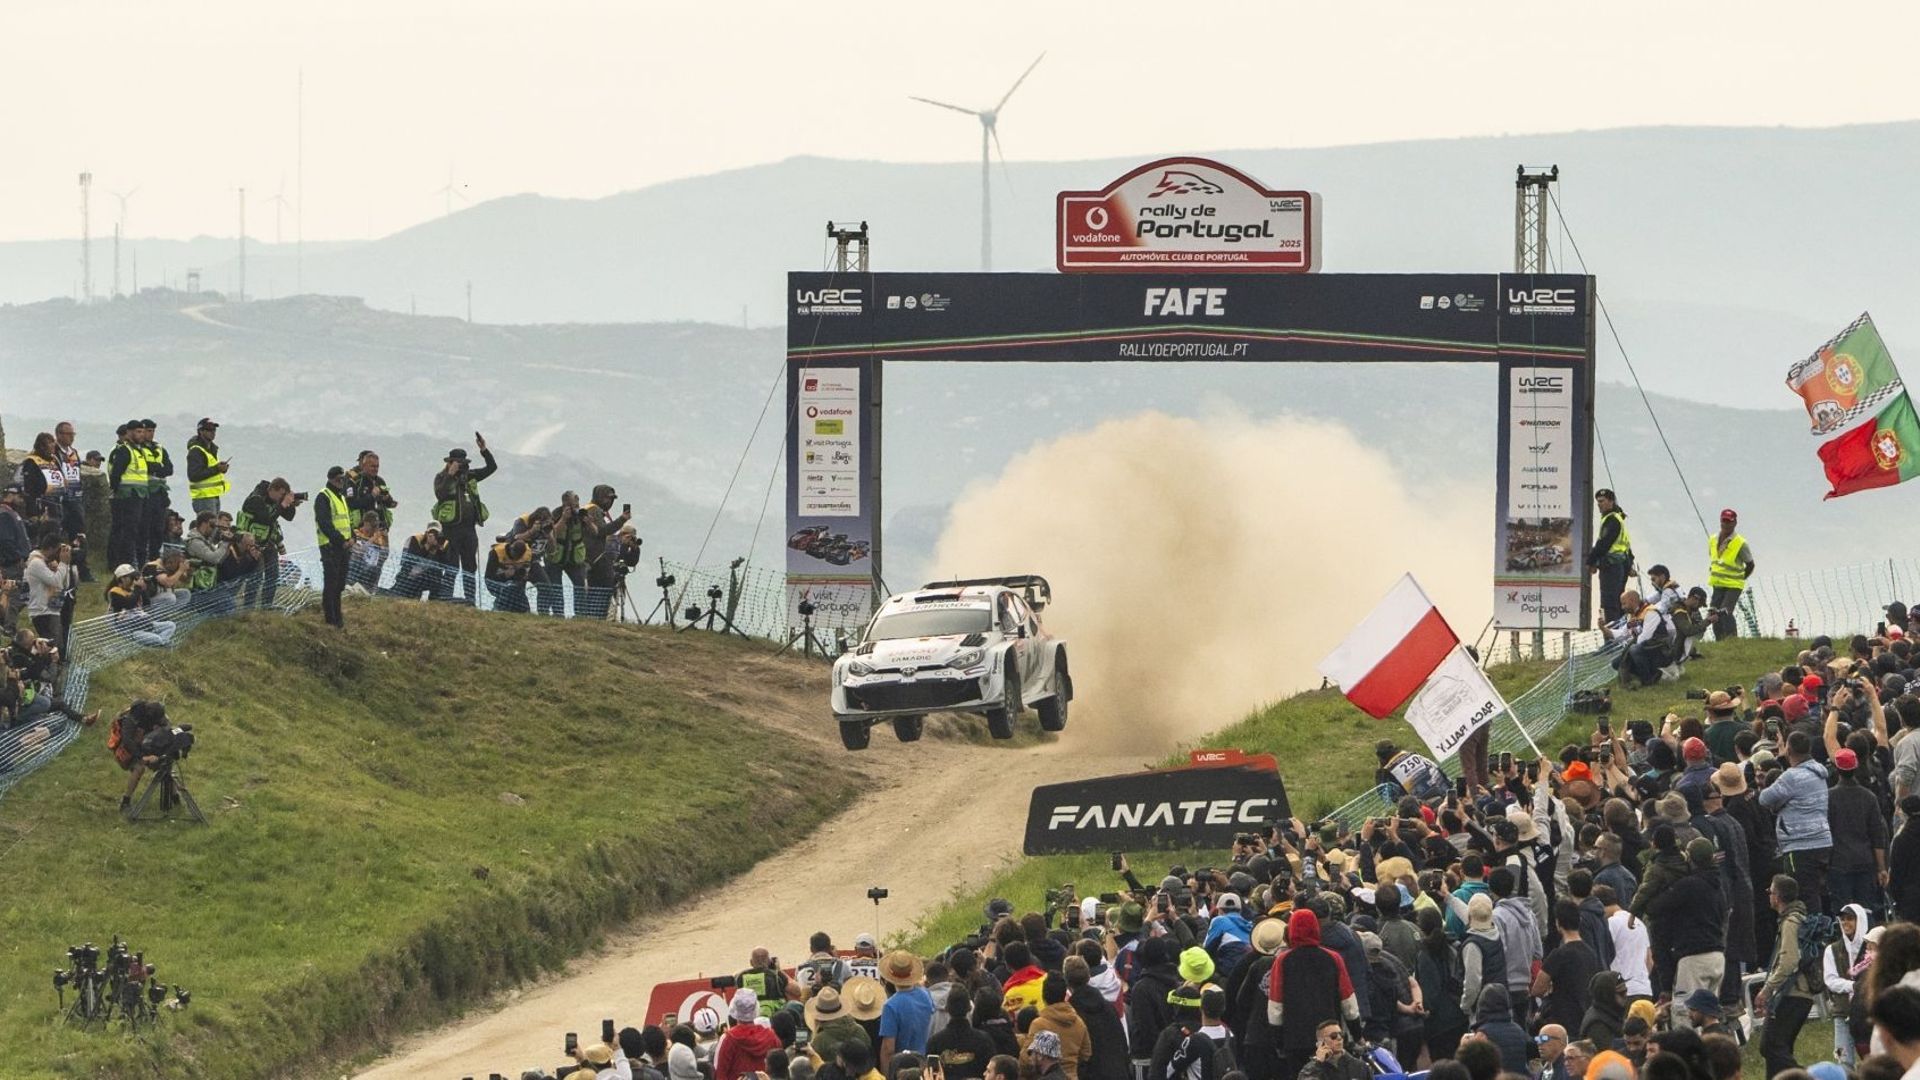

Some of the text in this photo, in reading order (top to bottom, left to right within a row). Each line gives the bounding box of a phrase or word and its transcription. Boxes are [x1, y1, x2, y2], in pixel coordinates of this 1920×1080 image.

[1139, 204, 1216, 219] rally de
[1073, 233, 1121, 243] vodafone
[1136, 219, 1274, 243] Portugal
[1279, 239, 1301, 248] 2025
[1120, 252, 1249, 262] AUTOMÓVEL CLUB DE PORTUGAL
[797, 288, 863, 304] WRC
[1144, 288, 1228, 316] FAFE
[1509, 288, 1576, 304] WRC
[1119, 343, 1249, 357] RALLYDEPORTUGAL.PT
[1519, 377, 1563, 387] WRC
[820, 407, 852, 416] vodafone
[1521, 592, 1542, 602] visit
[1521, 603, 1571, 620] Portugal
[1196, 753, 1226, 762] WRC
[1399, 755, 1421, 774] 250
[1048, 798, 1270, 830] FANATEC
